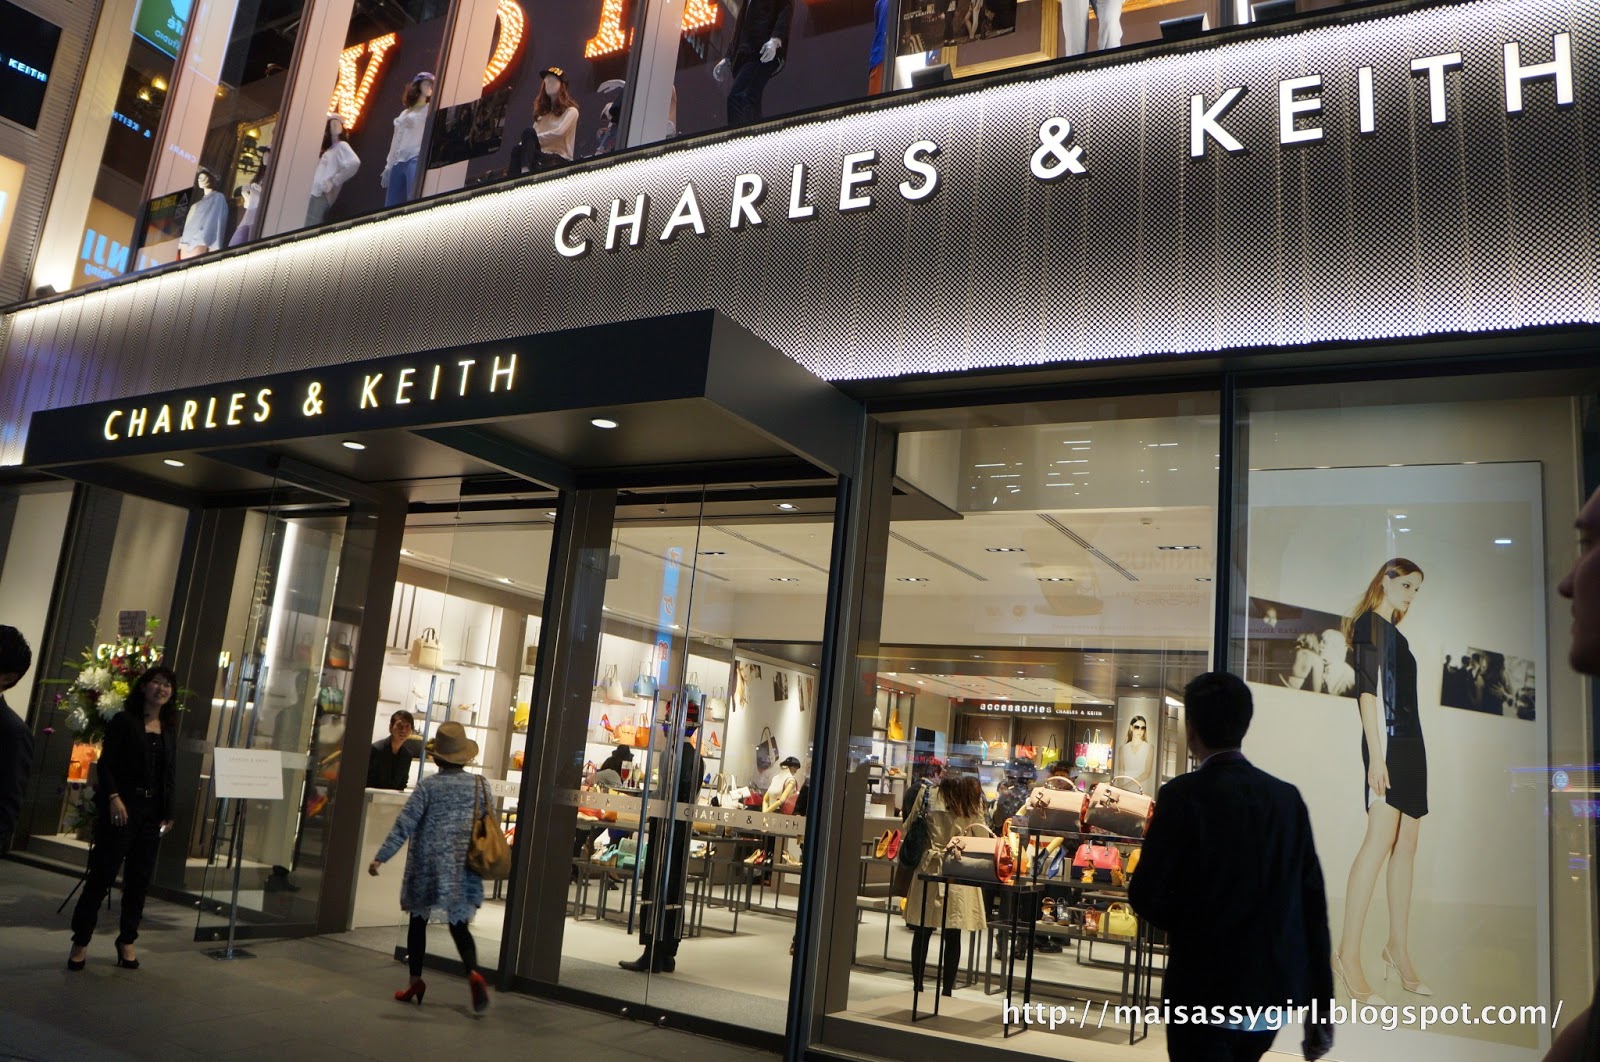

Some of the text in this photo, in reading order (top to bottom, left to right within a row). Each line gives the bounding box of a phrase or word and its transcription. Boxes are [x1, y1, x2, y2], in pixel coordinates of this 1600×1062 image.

[9, 58, 47, 82] KEITH
[554, 32, 1575, 259] CHARLES & KEITH
[104, 353, 518, 441] CHARLES & KEITH
[980, 703, 1052, 714] accessories
[490, 781, 516, 794] EITH
[683, 807, 737, 823] CHARLES
[746, 815, 753, 825] &
